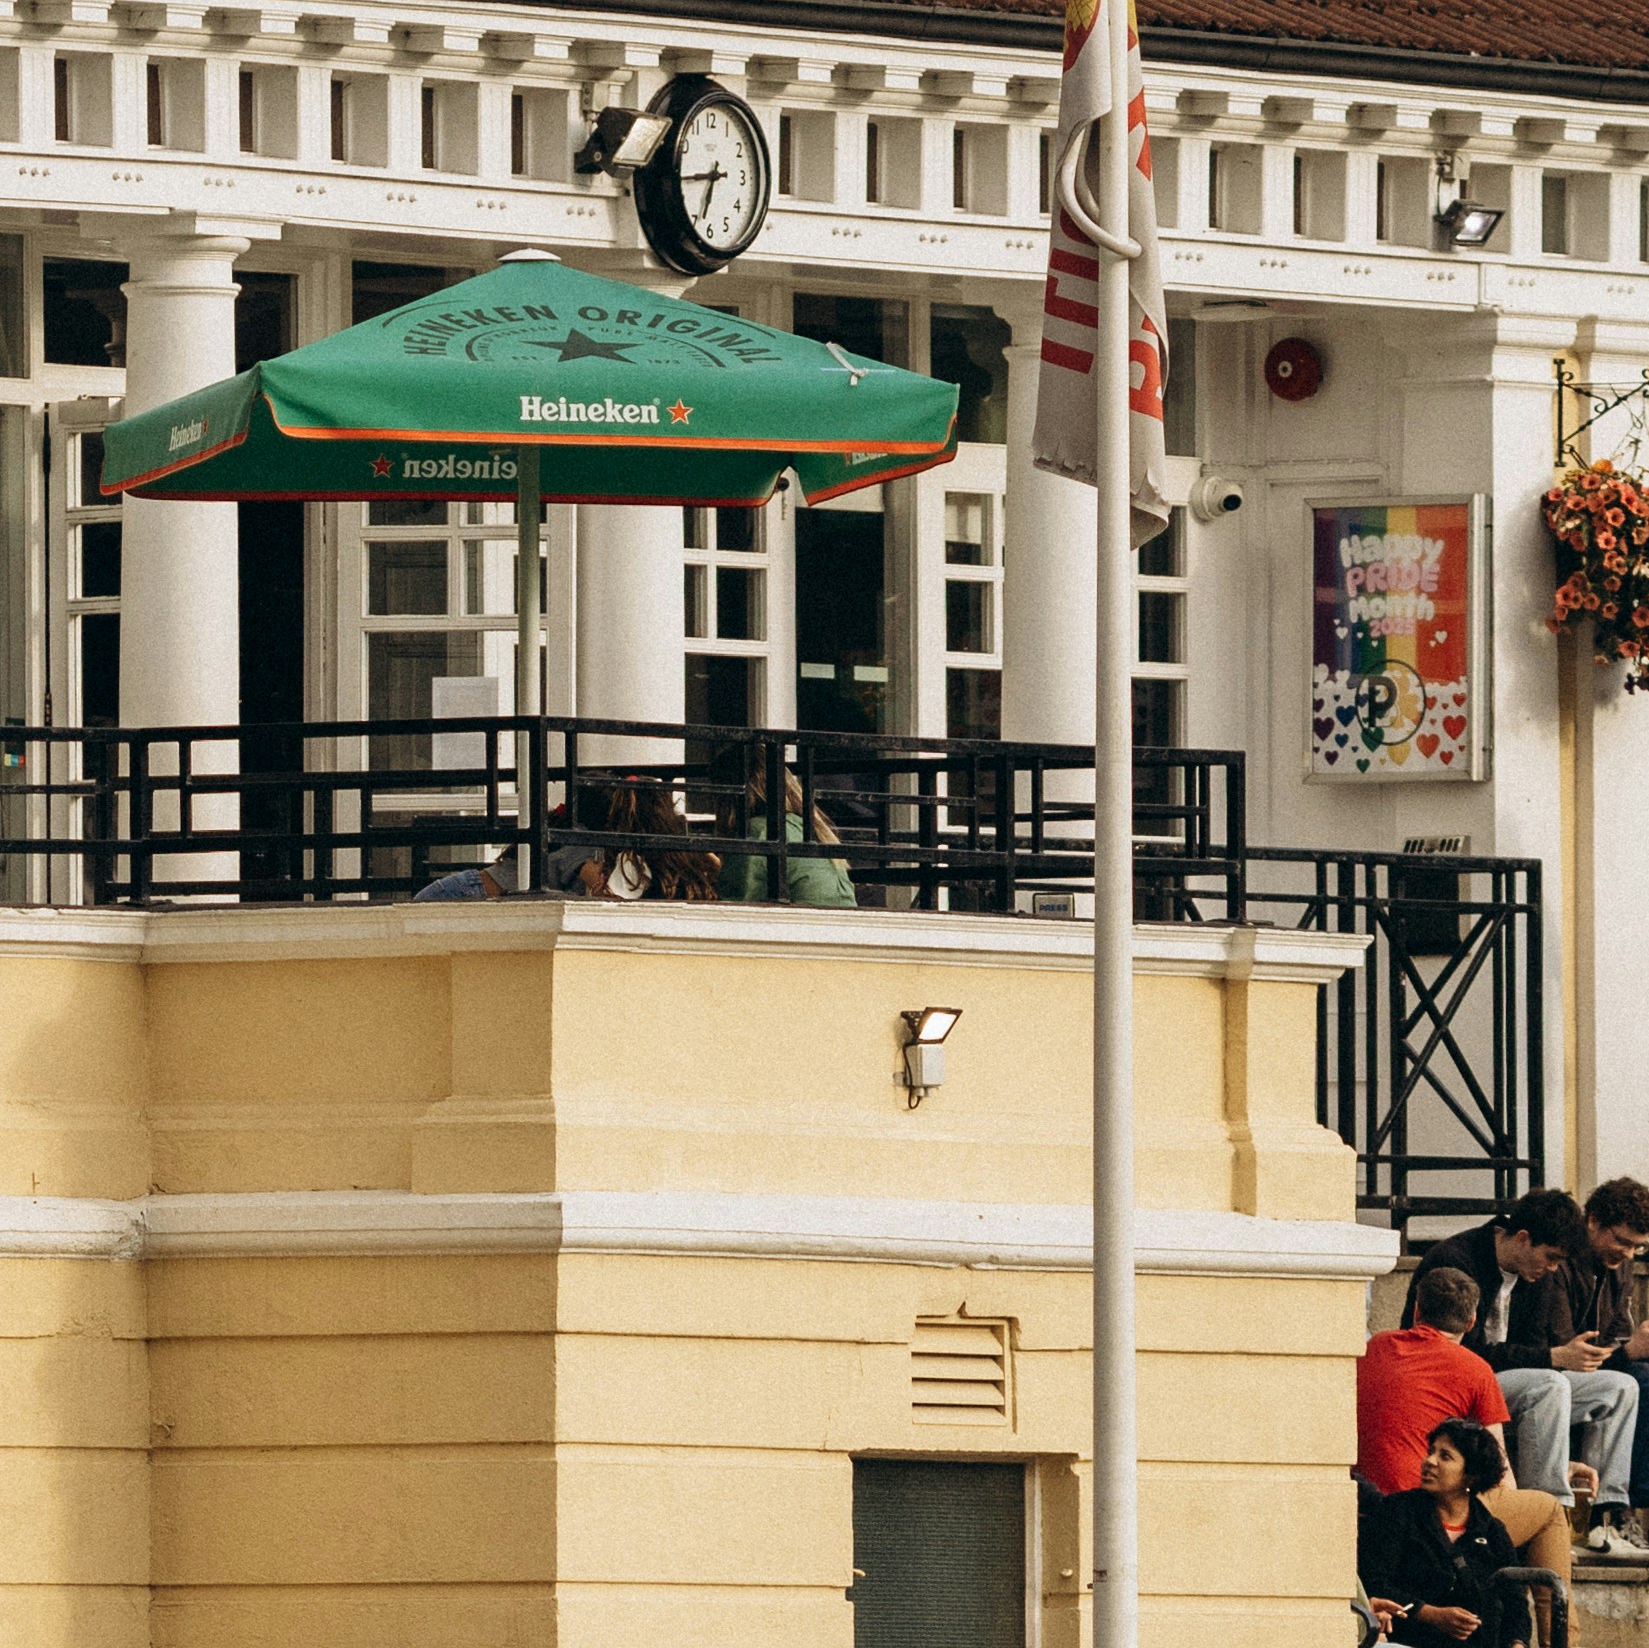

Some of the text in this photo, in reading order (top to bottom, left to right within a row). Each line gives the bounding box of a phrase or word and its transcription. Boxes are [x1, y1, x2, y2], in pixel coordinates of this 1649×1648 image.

[706, 113, 716, 129] 12
[725, 121, 729, 137] 1
[736, 142, 743, 158] 2
[740, 170, 746, 186] 3
[733, 198, 741, 213] 4
[706, 223, 713, 239] 6
[723, 217, 730, 232] 5
[403, 305, 782, 364] HEINEKEN ORIGINAL
[519, 396, 660, 424] Heineken
[169, 419, 202, 451] Heineken
[1340, 534, 1445, 569] Happy
[1346, 562, 1440, 597] PRIDE
[1349, 593, 1435, 623] Month
